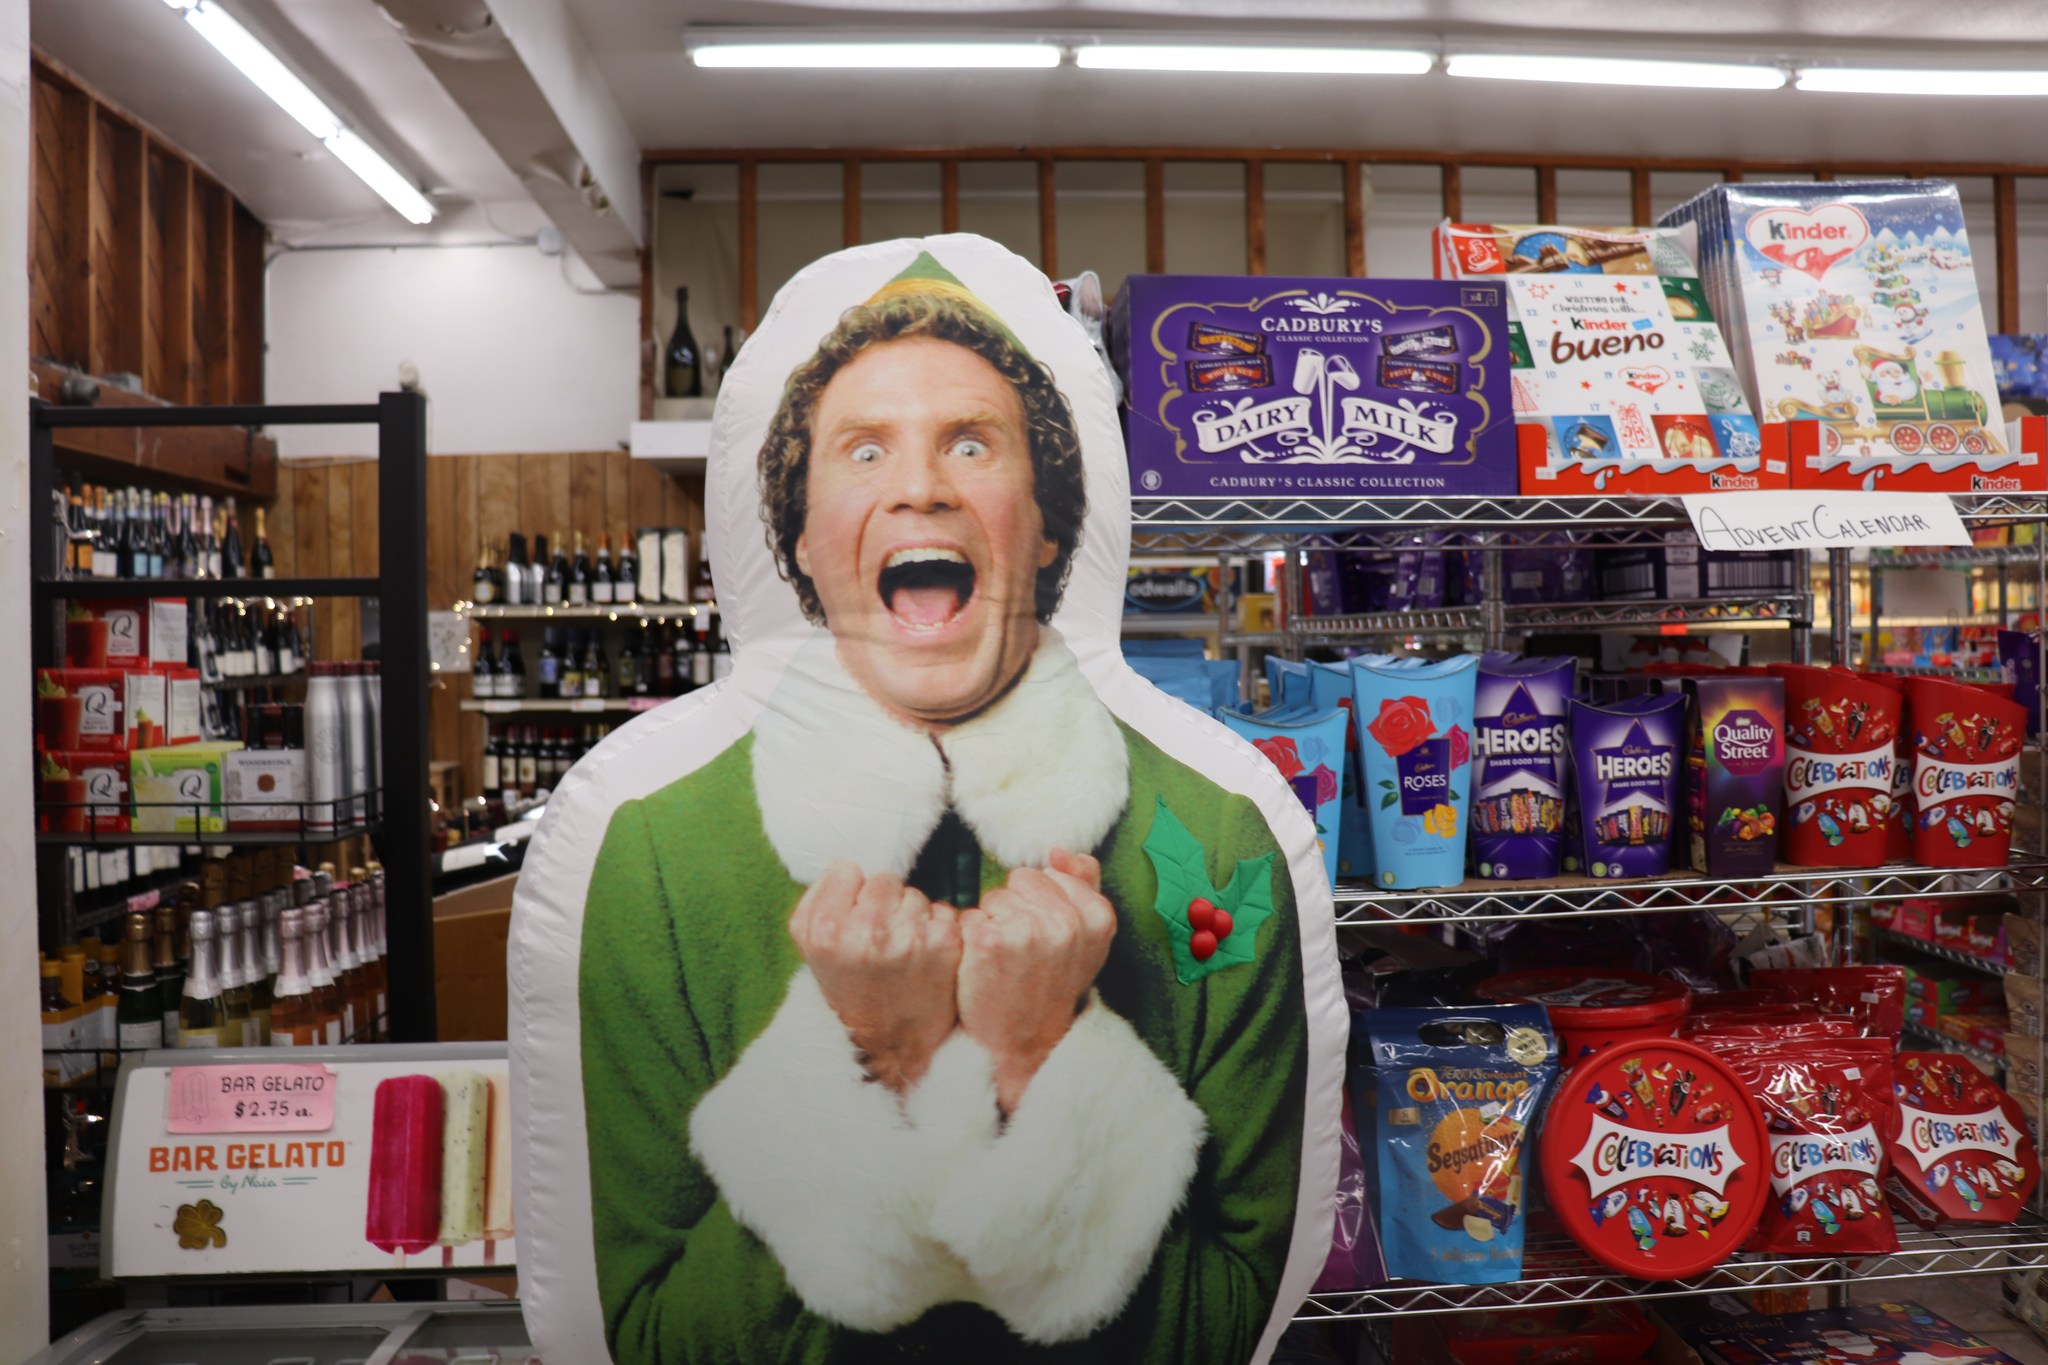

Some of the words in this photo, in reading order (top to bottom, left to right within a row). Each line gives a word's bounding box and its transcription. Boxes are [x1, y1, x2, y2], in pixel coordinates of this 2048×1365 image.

[1552, 304, 1609, 314] Christmas
[1260, 316, 1384, 334] CADBURY'S
[1276, 335, 1314, 344] CLASSIC
[1316, 335, 1370, 343] COLLECTION
[1550, 330, 1665, 365] bueno
[1215, 403, 1300, 444] DAIRY
[1354, 405, 1439, 445] MILK
[1209, 476, 1294, 488] CADBURY'S
[1296, 476, 1356, 488] CLASSIC
[1359, 476, 1446, 488] COLLECTION
[1128, 578, 1197, 597] odwalla
[111, 614, 132, 639] Q
[85, 690, 106, 716] Q
[1472, 723, 1565, 757] HEROES
[1713, 723, 1774, 747] Quality
[1489, 758, 1511, 767] SHARE
[1511, 757, 1533, 766] GOOD
[1720, 742, 1771, 760] Street
[1596, 751, 1672, 781] HEROES
[90, 772, 112, 798] Q
[180, 774, 202, 799] Q
[1403, 774, 1447, 792] ROSES
[1611, 781, 1630, 789] SHARE
[1630, 780, 1646, 788] GOOD
[221, 1076, 256, 1093] BAR
[262, 1075, 325, 1092] GELATO
[1406, 1066, 1530, 1108] Orange
[149, 1145, 219, 1173] BAR
[226, 1140, 345, 1170] GELATO
[220, 1174, 239, 1195] by
[240, 1173, 278, 1190] Naia
